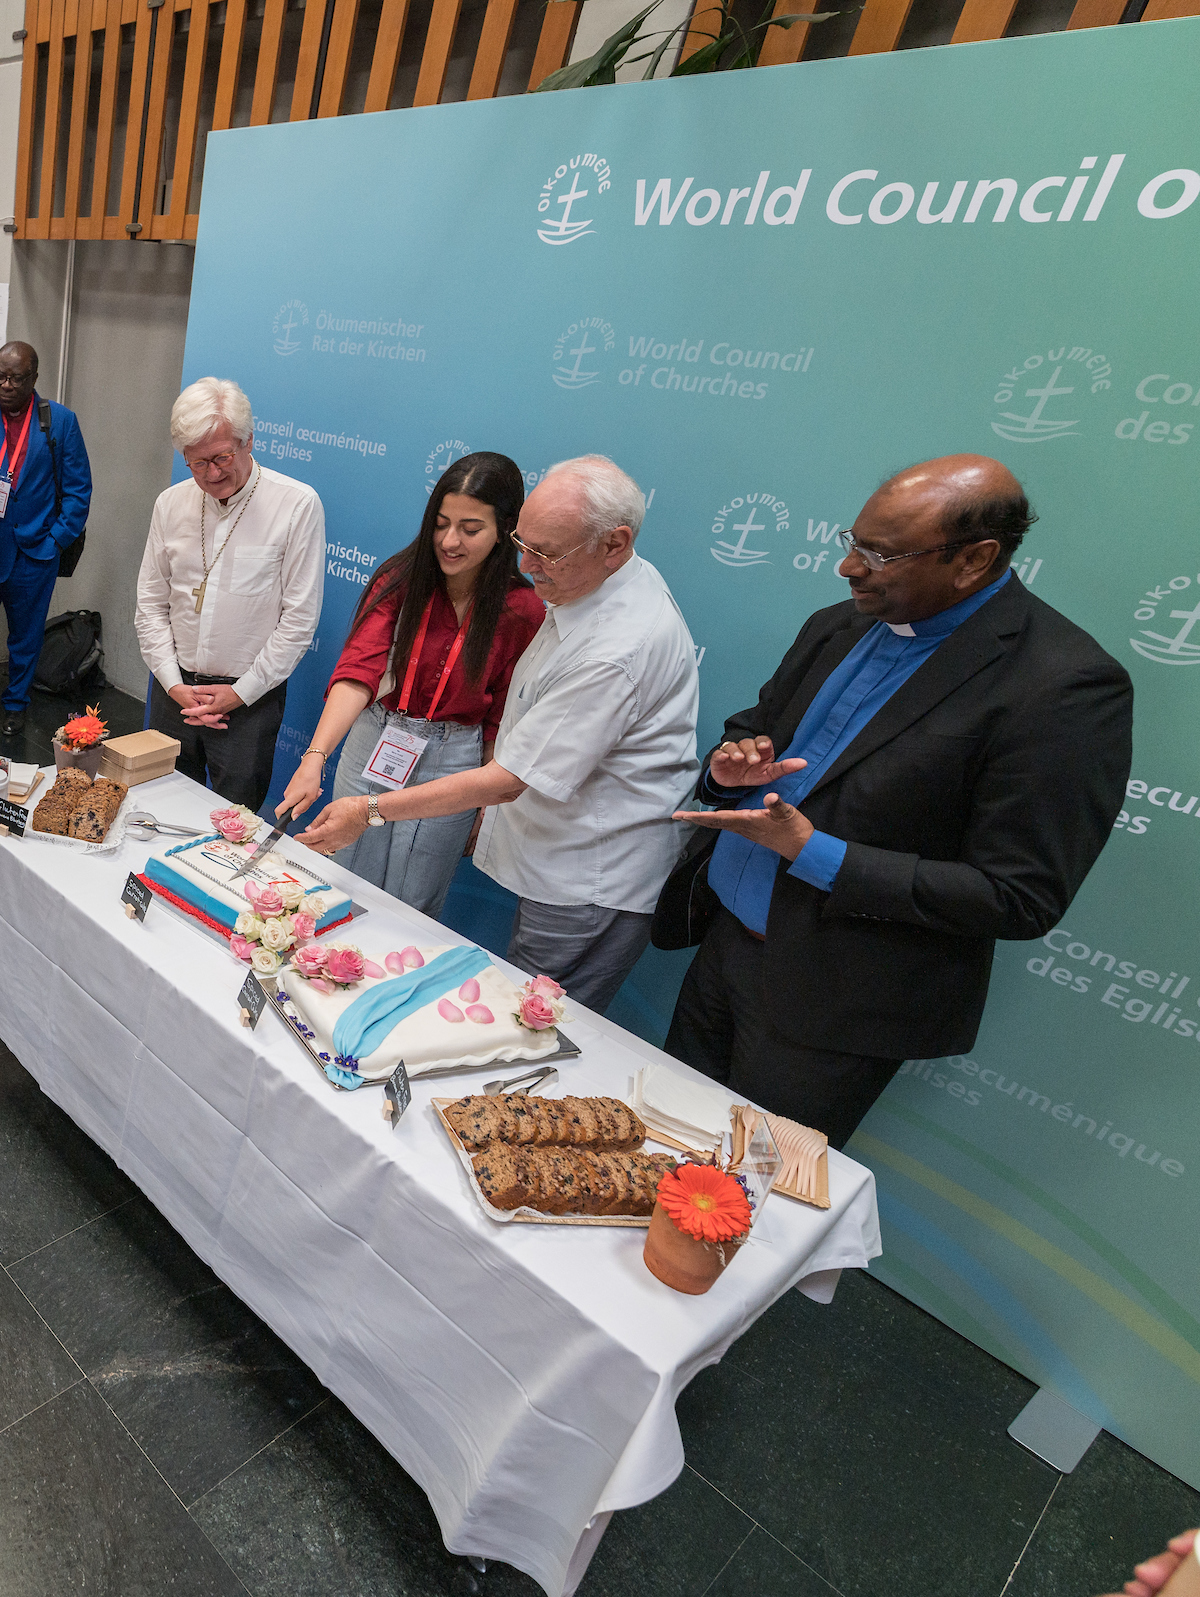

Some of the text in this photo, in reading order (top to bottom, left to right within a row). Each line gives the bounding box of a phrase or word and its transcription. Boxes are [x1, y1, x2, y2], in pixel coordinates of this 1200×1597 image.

[634, 168, 812, 226] World
[826, 153, 1127, 226] Council
[316, 310, 424, 338] Ökumenischer
[312, 335, 426, 362] Rat der Kirchen
[628, 335, 815, 373] World Council
[618, 364, 769, 400] of Churches
[1135, 374, 1200, 406] Co
[296, 427, 387, 457] œcuménique
[1115, 410, 1195, 445] des
[270, 439, 313, 462] Eglises
[325, 541, 377, 567] nischer
[792, 550, 830, 573] of
[1026, 956, 1093, 994] des
[1043, 928, 1190, 1000] Conseil
